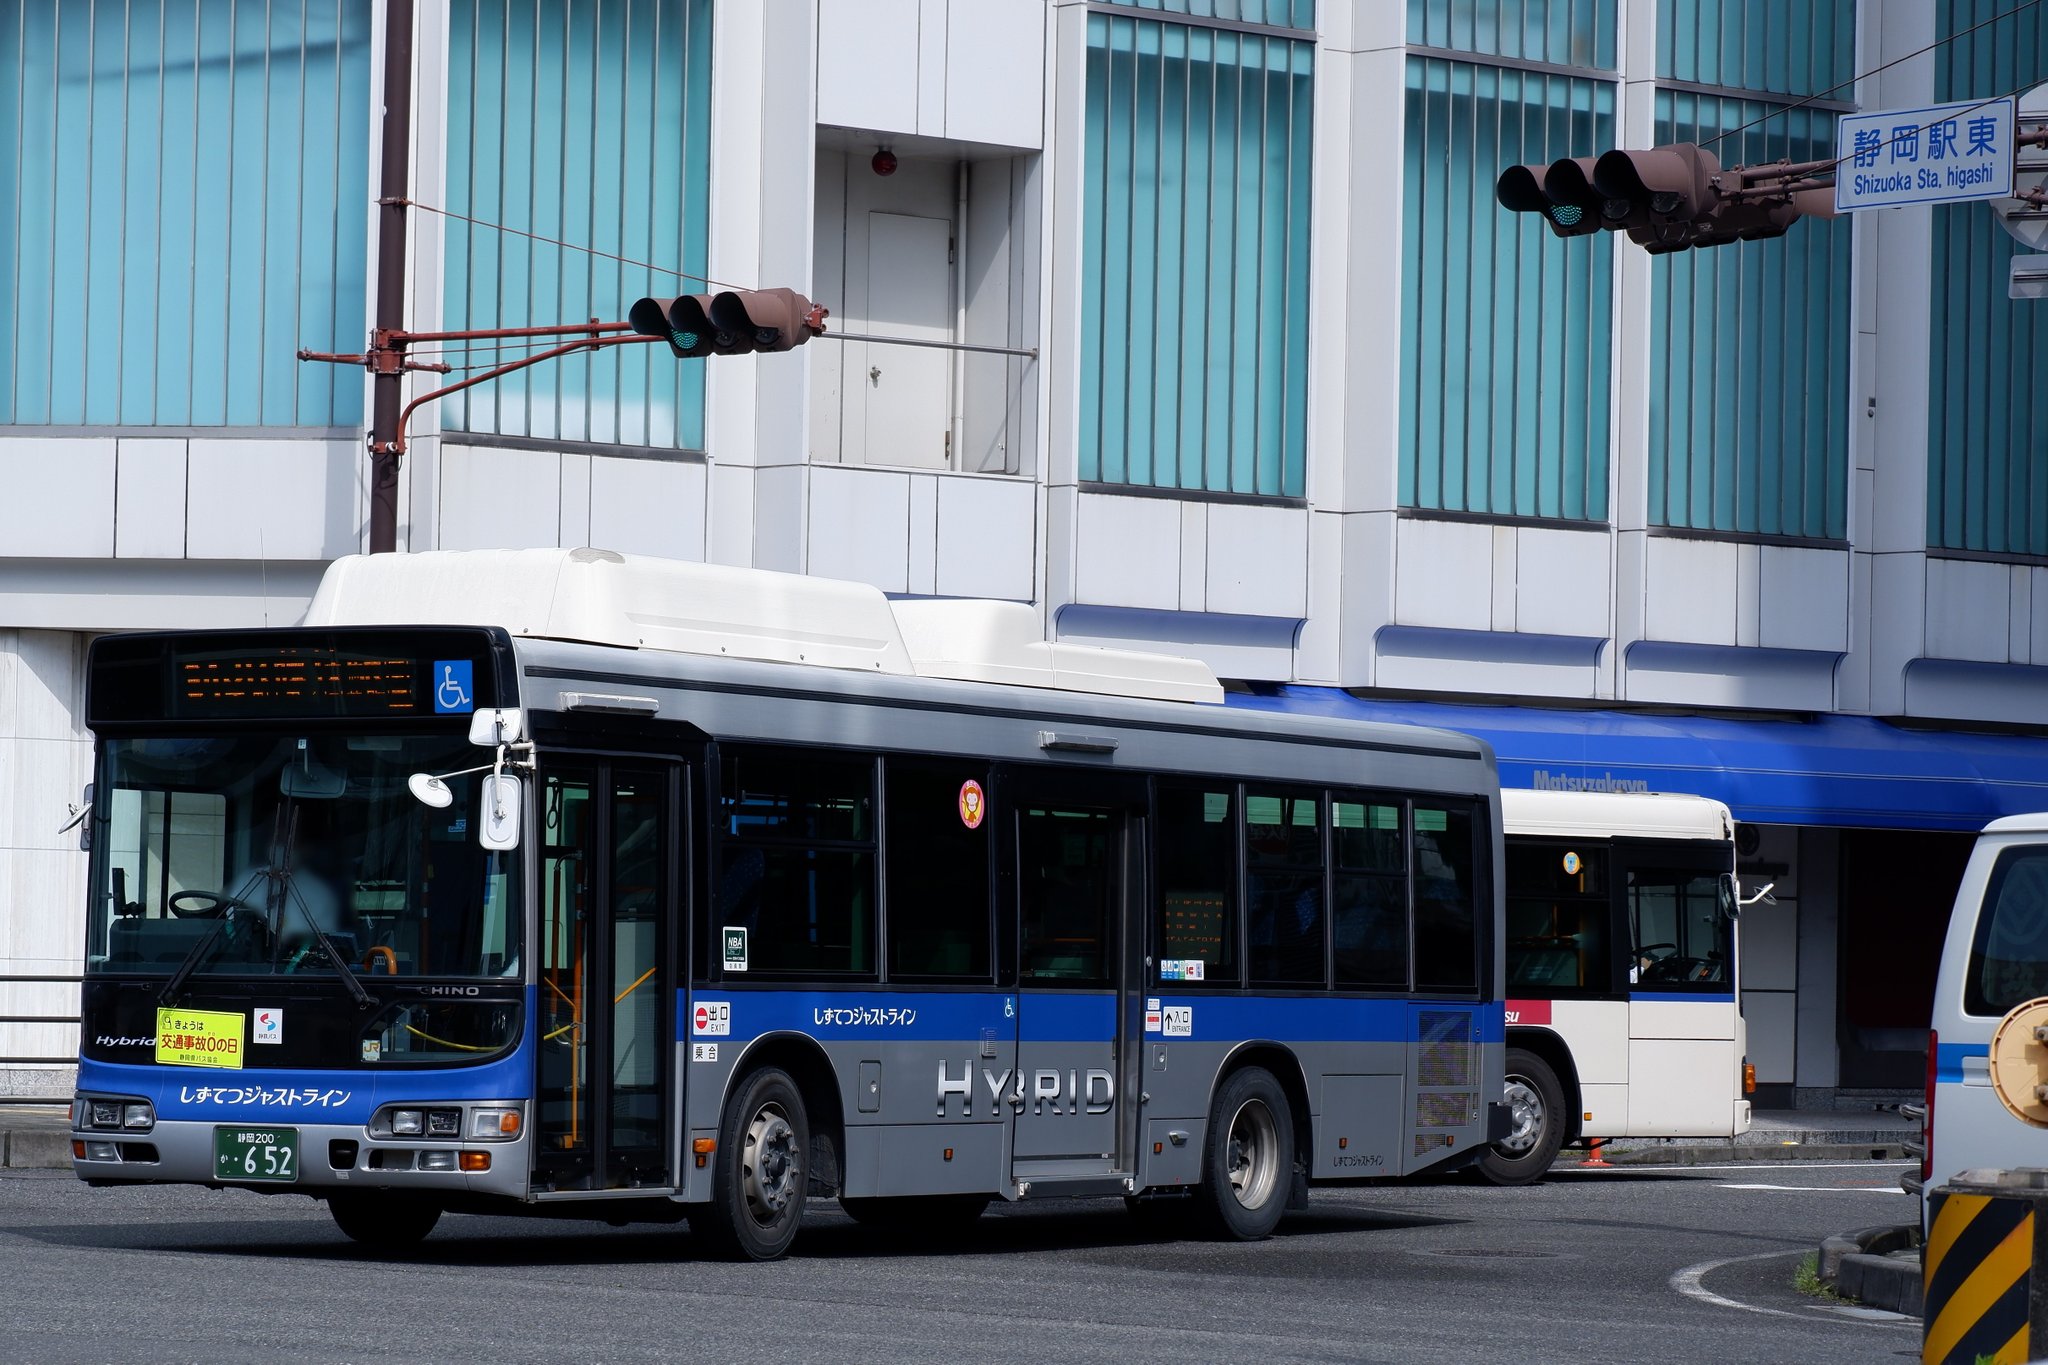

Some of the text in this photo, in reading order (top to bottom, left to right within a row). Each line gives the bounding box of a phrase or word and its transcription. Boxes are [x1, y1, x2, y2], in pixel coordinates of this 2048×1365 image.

[1854, 116, 1997, 169] 静岡駅東
[1854, 162, 1993, 195] Shizuoka Sta. higashi
[431, 986, 480, 996] HINO
[709, 1005, 728, 1021] 出口
[814, 1005, 917, 1026] しずてつジャストライン
[1174, 1011, 1188, 1023] 入口
[175, 1020, 204, 1031] きょうは
[710, 1023, 725, 1033] EXIT
[1171, 1025, 1191, 1033] ENTRANCE
[95, 1035, 157, 1047] Hybrid
[695, 1046, 716, 1060] 乗合
[936, 1059, 1115, 1116] HYBRID
[180, 1085, 351, 1107] しずてつジャストライン
